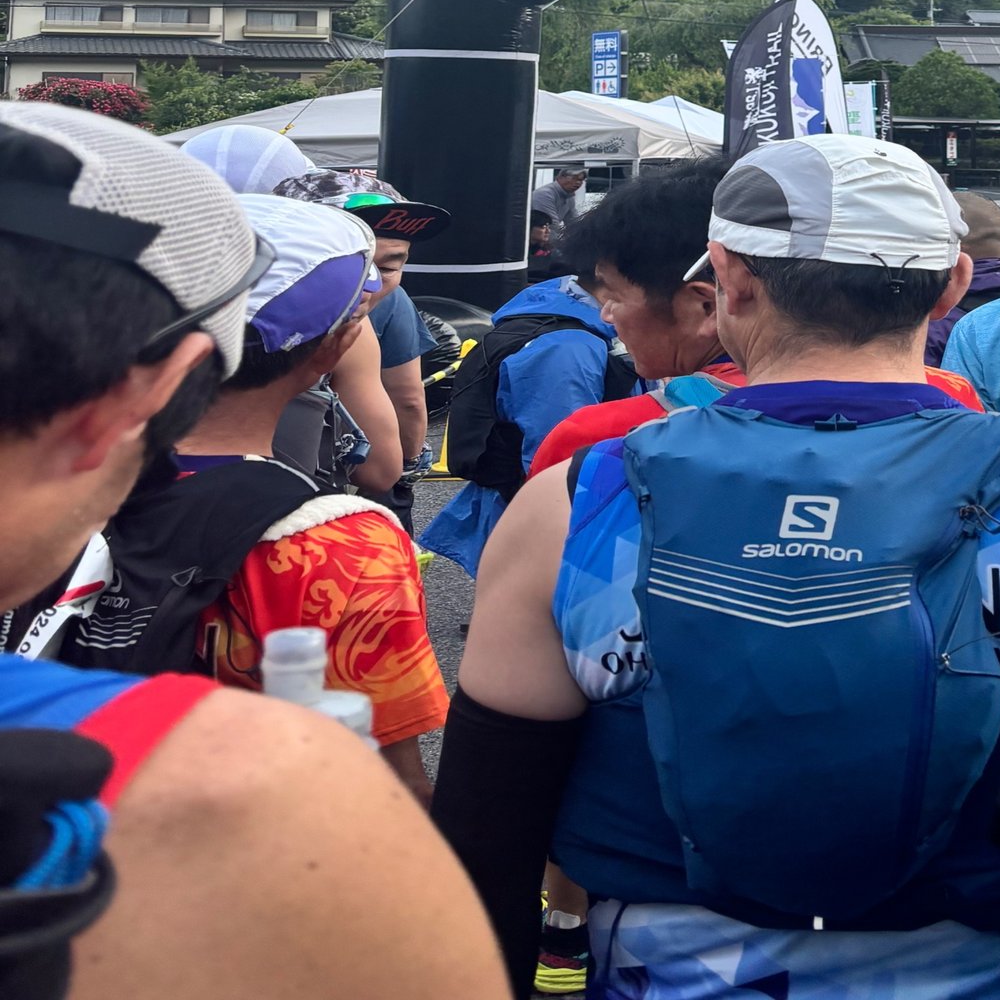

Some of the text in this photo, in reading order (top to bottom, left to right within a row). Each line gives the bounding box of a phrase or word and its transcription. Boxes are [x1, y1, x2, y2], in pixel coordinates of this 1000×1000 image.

[595, 37, 617, 53] 無料
[596, 63, 604, 75] P
[756, 80, 779, 146] KUKUJI
[373, 208, 436, 236] Buff
[30, 606, 57, 638] 024
